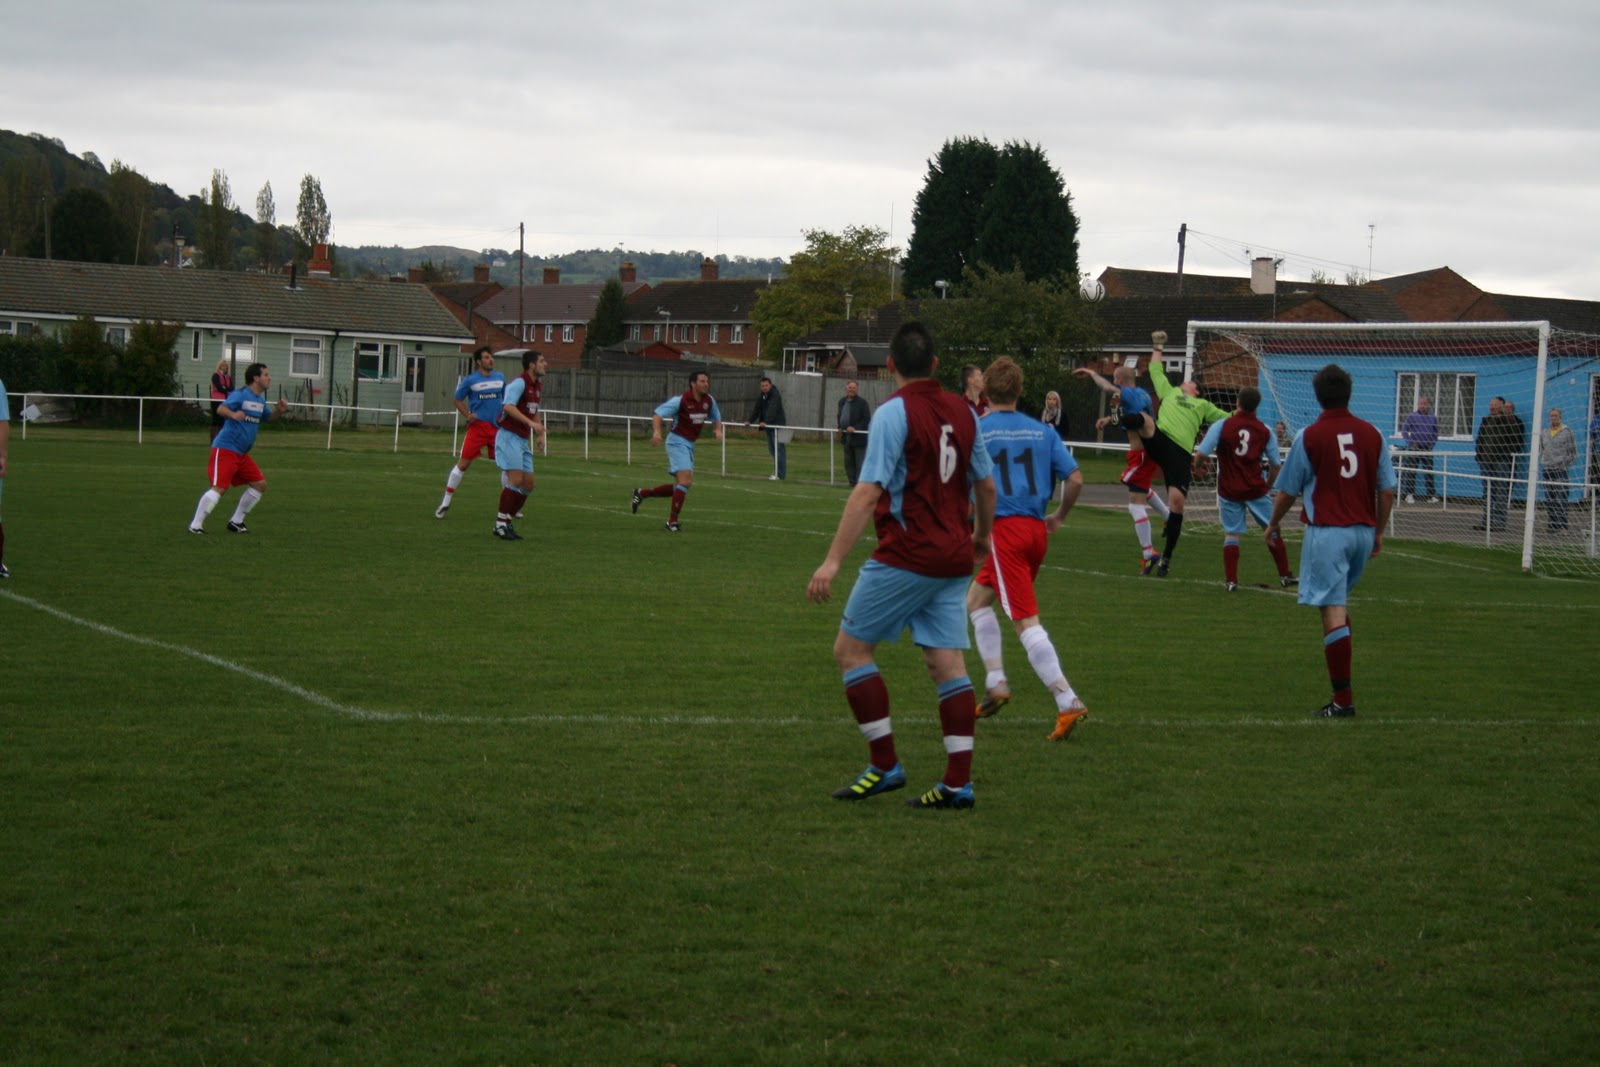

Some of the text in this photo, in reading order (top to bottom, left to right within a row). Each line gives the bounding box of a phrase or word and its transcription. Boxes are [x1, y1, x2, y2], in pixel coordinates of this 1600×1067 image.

[939, 424, 957, 484] 6
[1234, 429, 1250, 457] 3
[1336, 433, 1358, 479] 5
[992, 447, 1037, 496] 11
